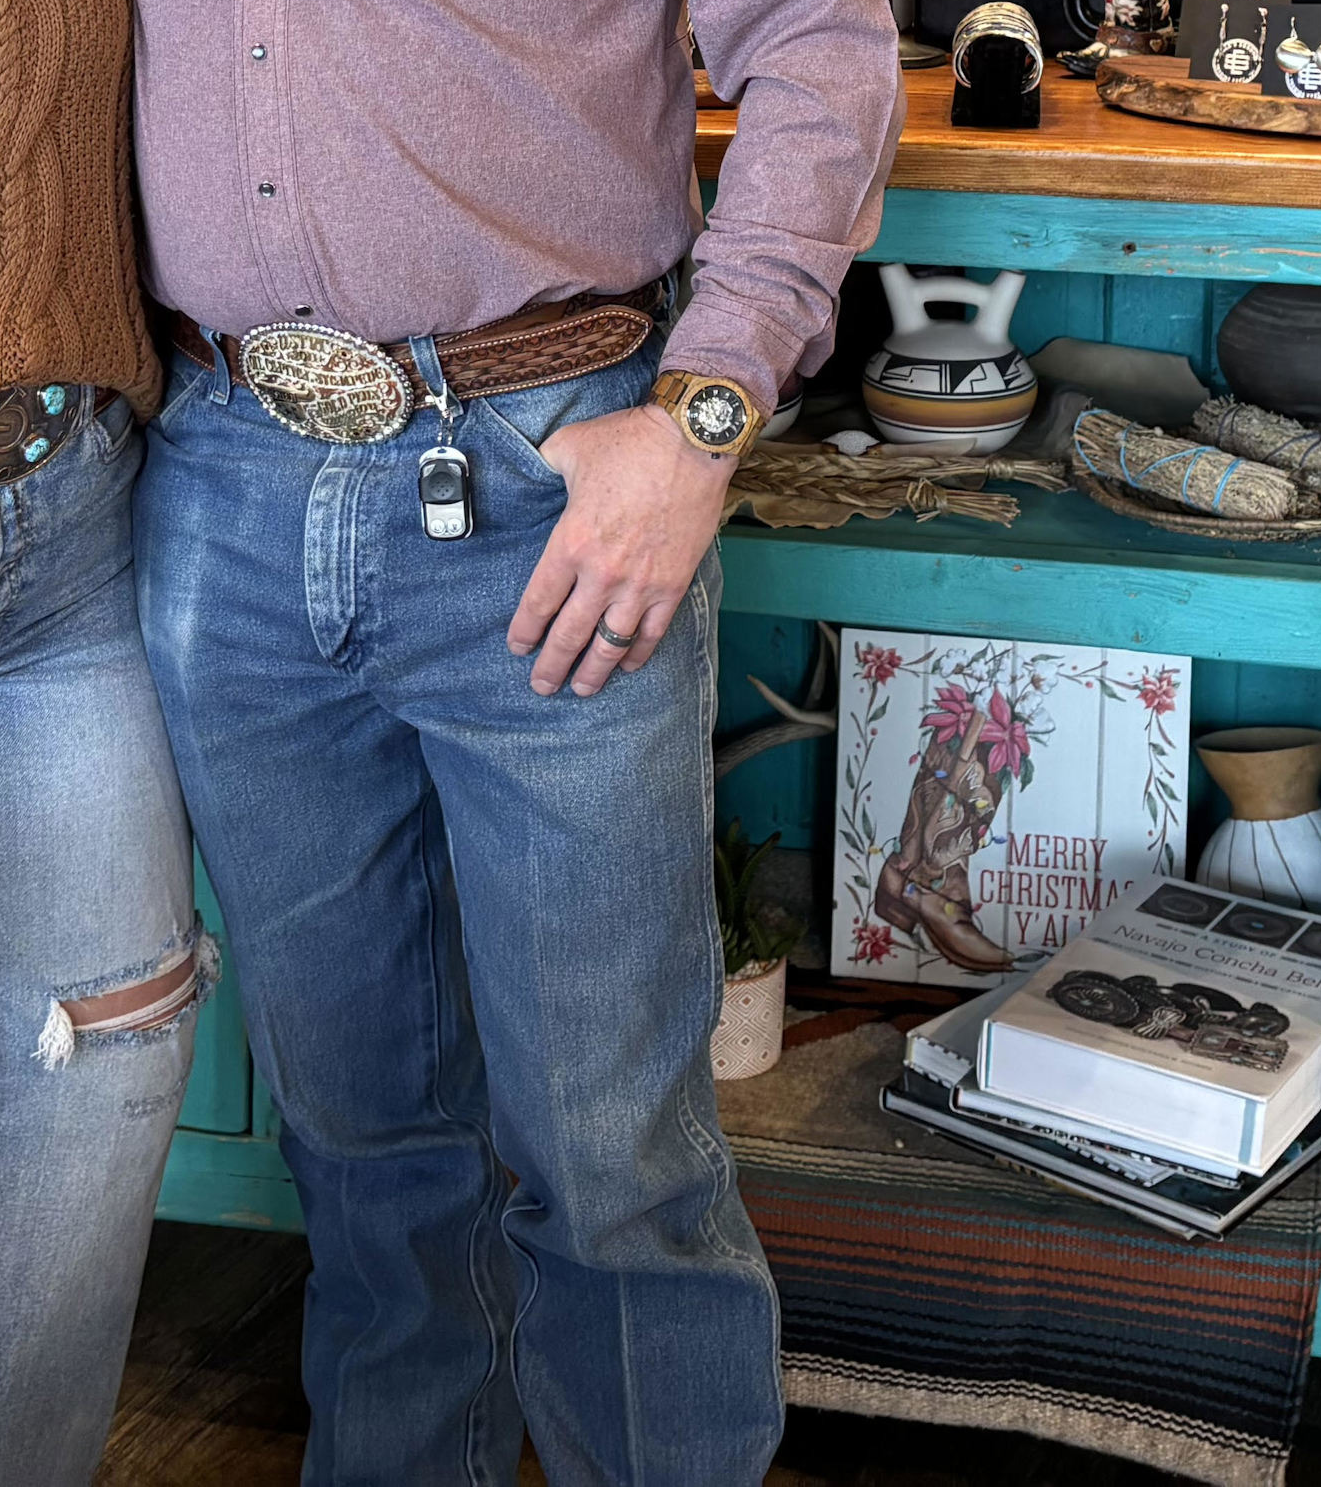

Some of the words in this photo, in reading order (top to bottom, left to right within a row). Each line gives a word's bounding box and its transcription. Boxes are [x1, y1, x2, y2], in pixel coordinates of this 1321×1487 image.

[1007, 831, 1108, 872] MERRY
[1114, 924, 1188, 954] Navajo
[1194, 947, 1278, 978] Concha
[1197, 933, 1209, 941] A
[1212, 936, 1256, 953] STUDY
[1260, 948, 1278, 959] OF
